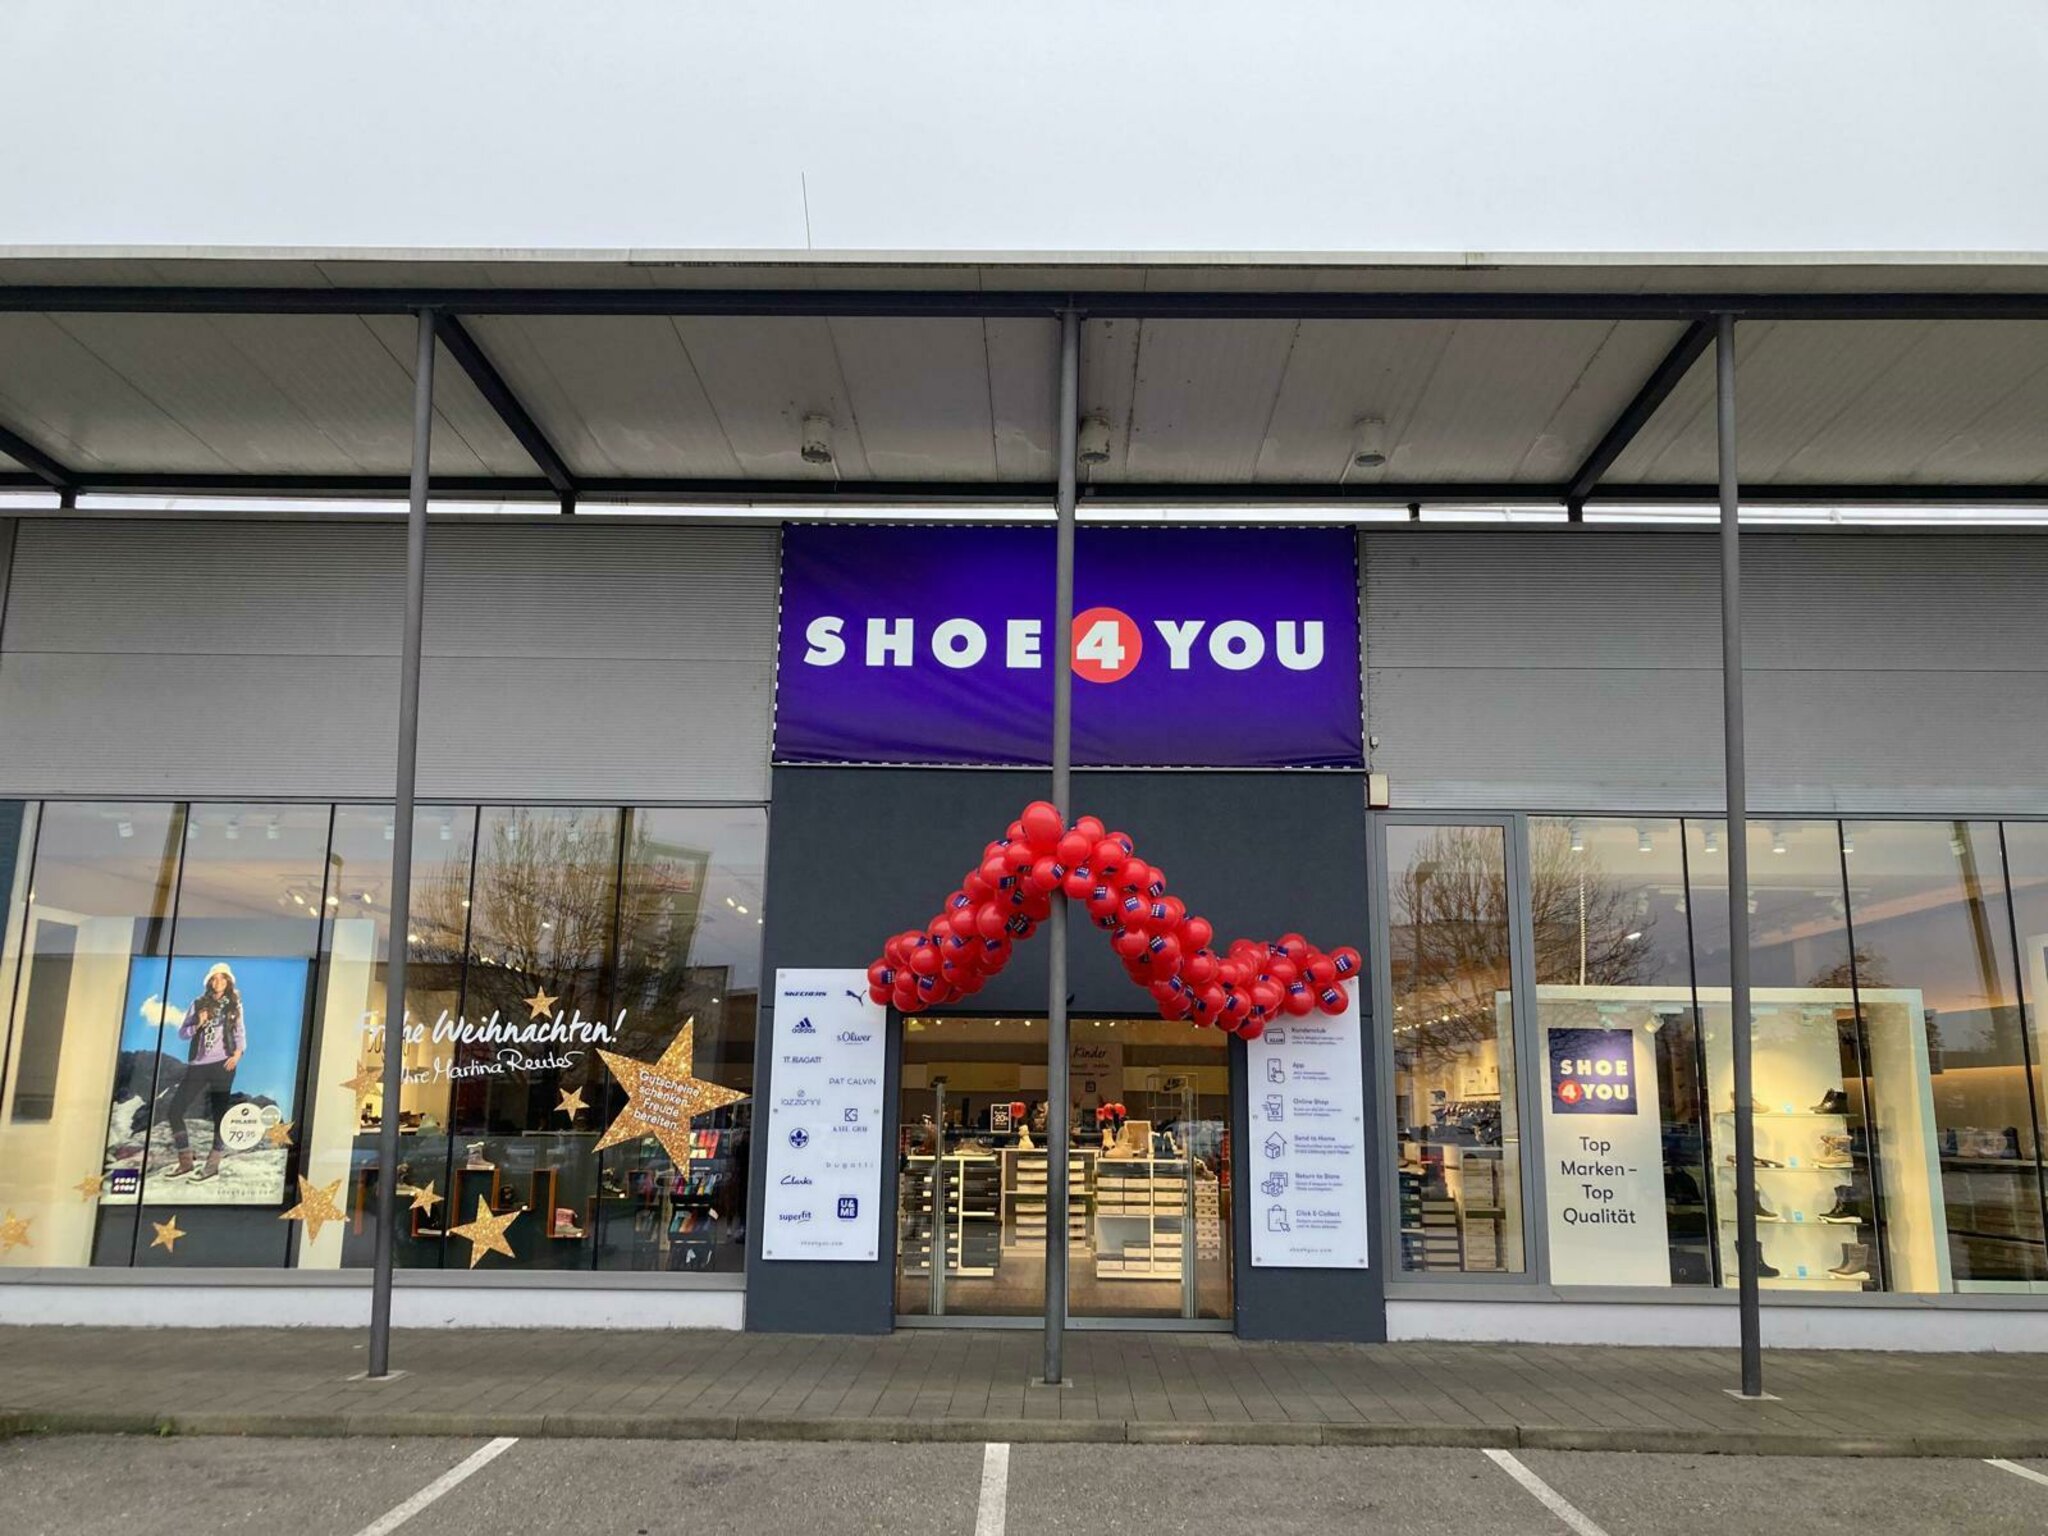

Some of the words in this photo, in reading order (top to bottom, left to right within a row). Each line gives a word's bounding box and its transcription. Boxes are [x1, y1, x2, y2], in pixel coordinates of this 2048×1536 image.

[803, 616, 1043, 669] SHOE
[1154, 619, 1326, 671] YOU
[432, 1008, 627, 1044] Weihnachten!
[1560, 1059, 1628, 1077] SHOE
[639, 1070, 700, 1097] Gutscheine
[643, 1097, 680, 1117] Freude
[1579, 1136, 1611, 1156] Top
[1561, 1160, 1625, 1176] Marken
[780, 1175, 812, 1185] Clarks
[1582, 1184, 1614, 1203] Top
[779, 1211, 811, 1222] superfit
[1563, 1207, 1637, 1225] Qualität
